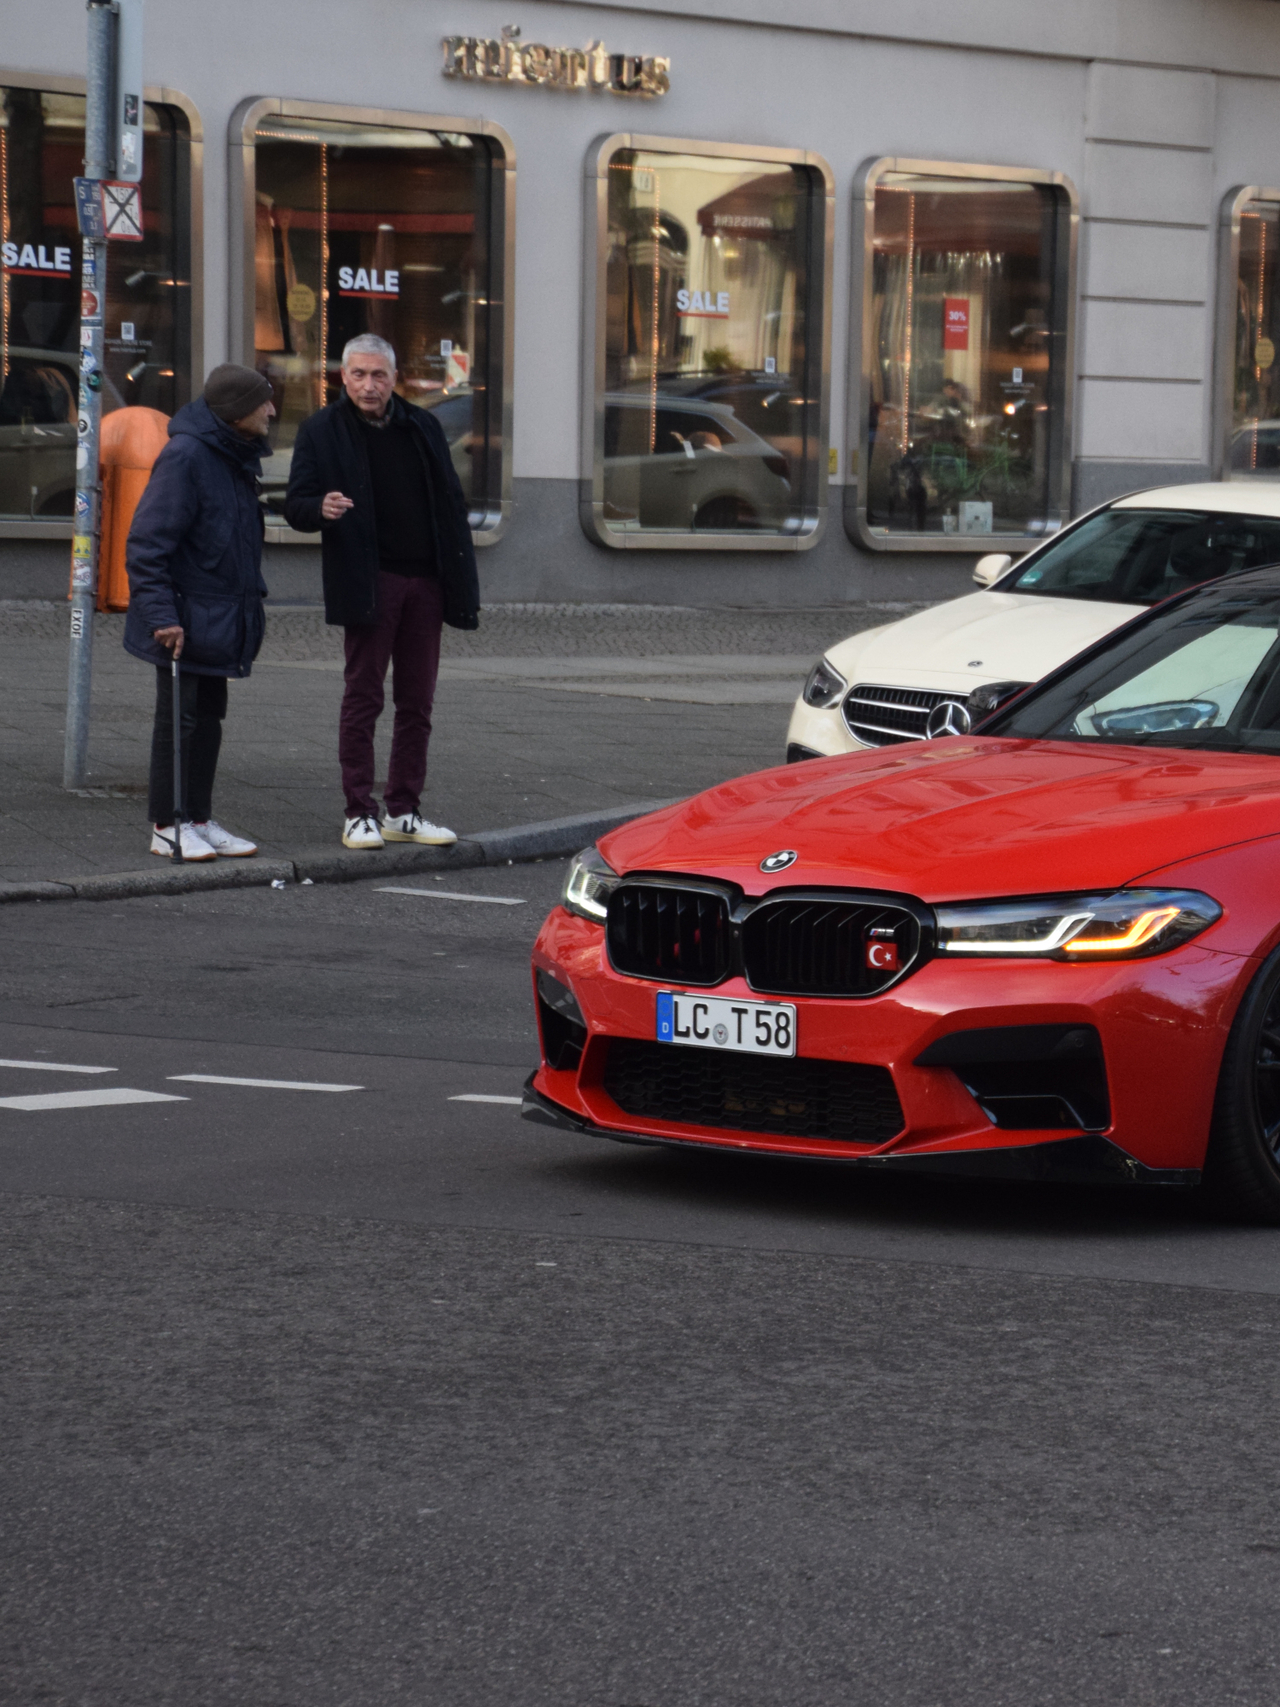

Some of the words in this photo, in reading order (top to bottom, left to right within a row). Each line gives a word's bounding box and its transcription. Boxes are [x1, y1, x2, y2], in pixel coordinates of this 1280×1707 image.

[1, 242, 72, 271] SALE
[338, 265, 400, 293] SALE
[676, 289, 730, 313] SALE
[948, 311, 967, 322] 30%
[662, 1022, 669, 1033] D
[674, 1001, 710, 1040] LC
